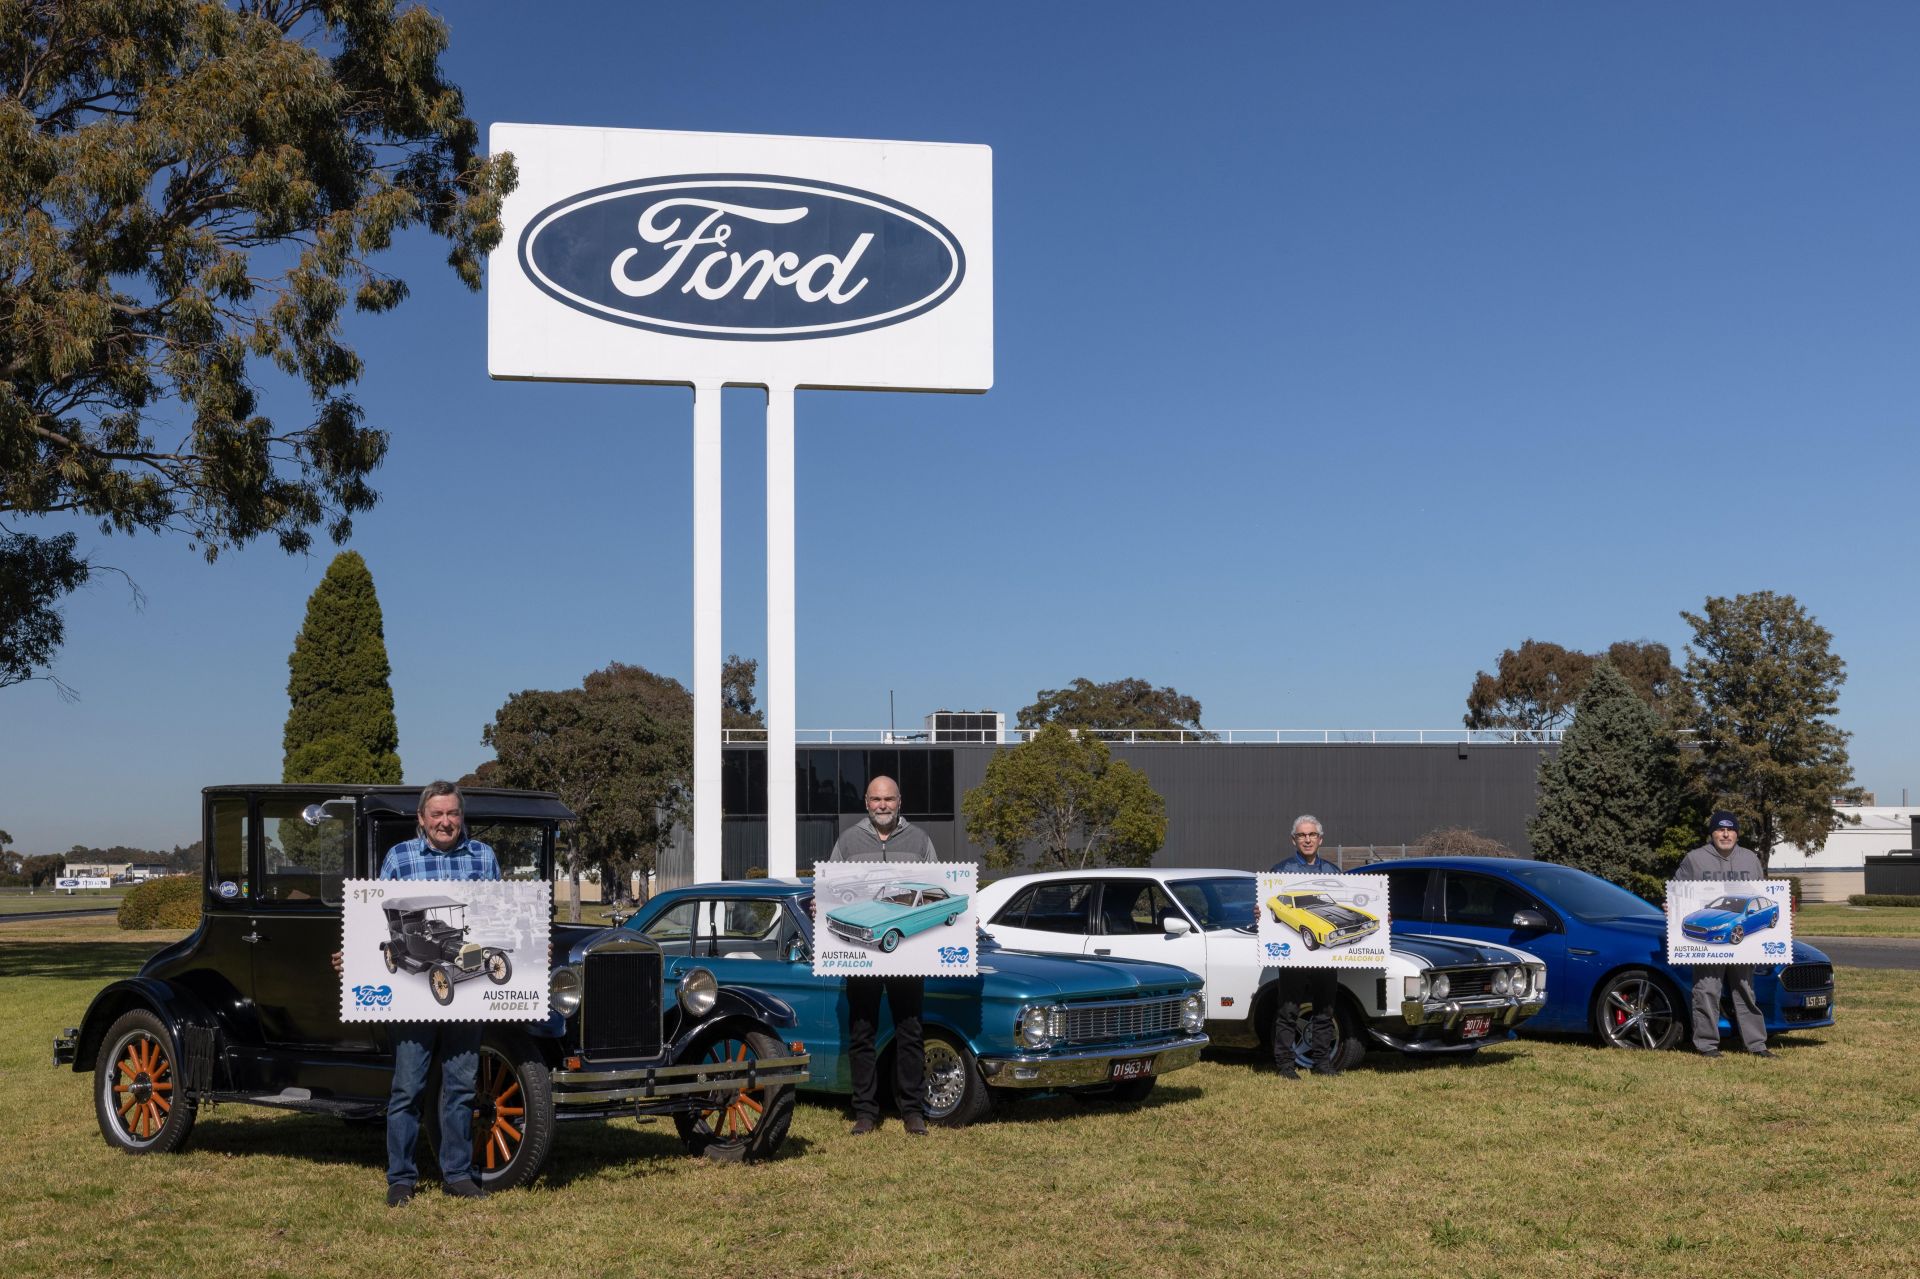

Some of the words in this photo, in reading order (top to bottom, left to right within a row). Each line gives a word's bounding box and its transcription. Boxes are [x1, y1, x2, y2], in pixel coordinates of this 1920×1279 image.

[611, 198, 875, 304] Ford
[821, 951, 867, 960] AUSTRALIA
[1348, 947, 1385, 955] AUSTRALIA
[822, 960, 836, 968] XP
[837, 960, 873, 968] FALCON
[356, 988, 392, 1003] Ford
[483, 990, 540, 1001] AUSTRALIA
[489, 1001, 527, 1011] MODEL
[529, 1001, 540, 1011] T
